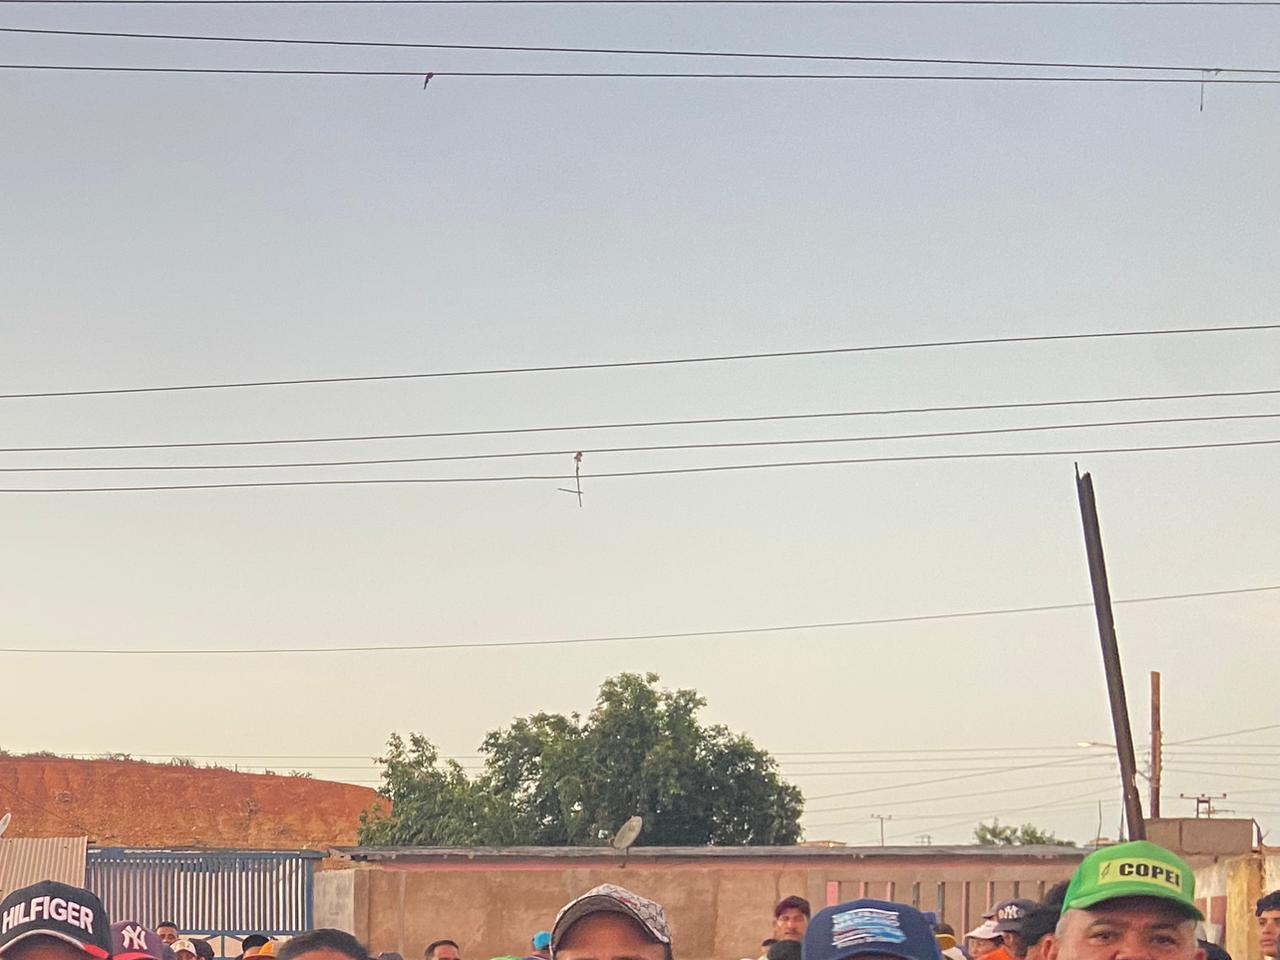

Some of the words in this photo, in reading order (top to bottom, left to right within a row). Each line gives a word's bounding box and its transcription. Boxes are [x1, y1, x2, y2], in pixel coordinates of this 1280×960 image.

[1119, 862, 1181, 887] COPEI
[1, 895, 94, 936] HILFIGER
[121, 925, 148, 950] NY
